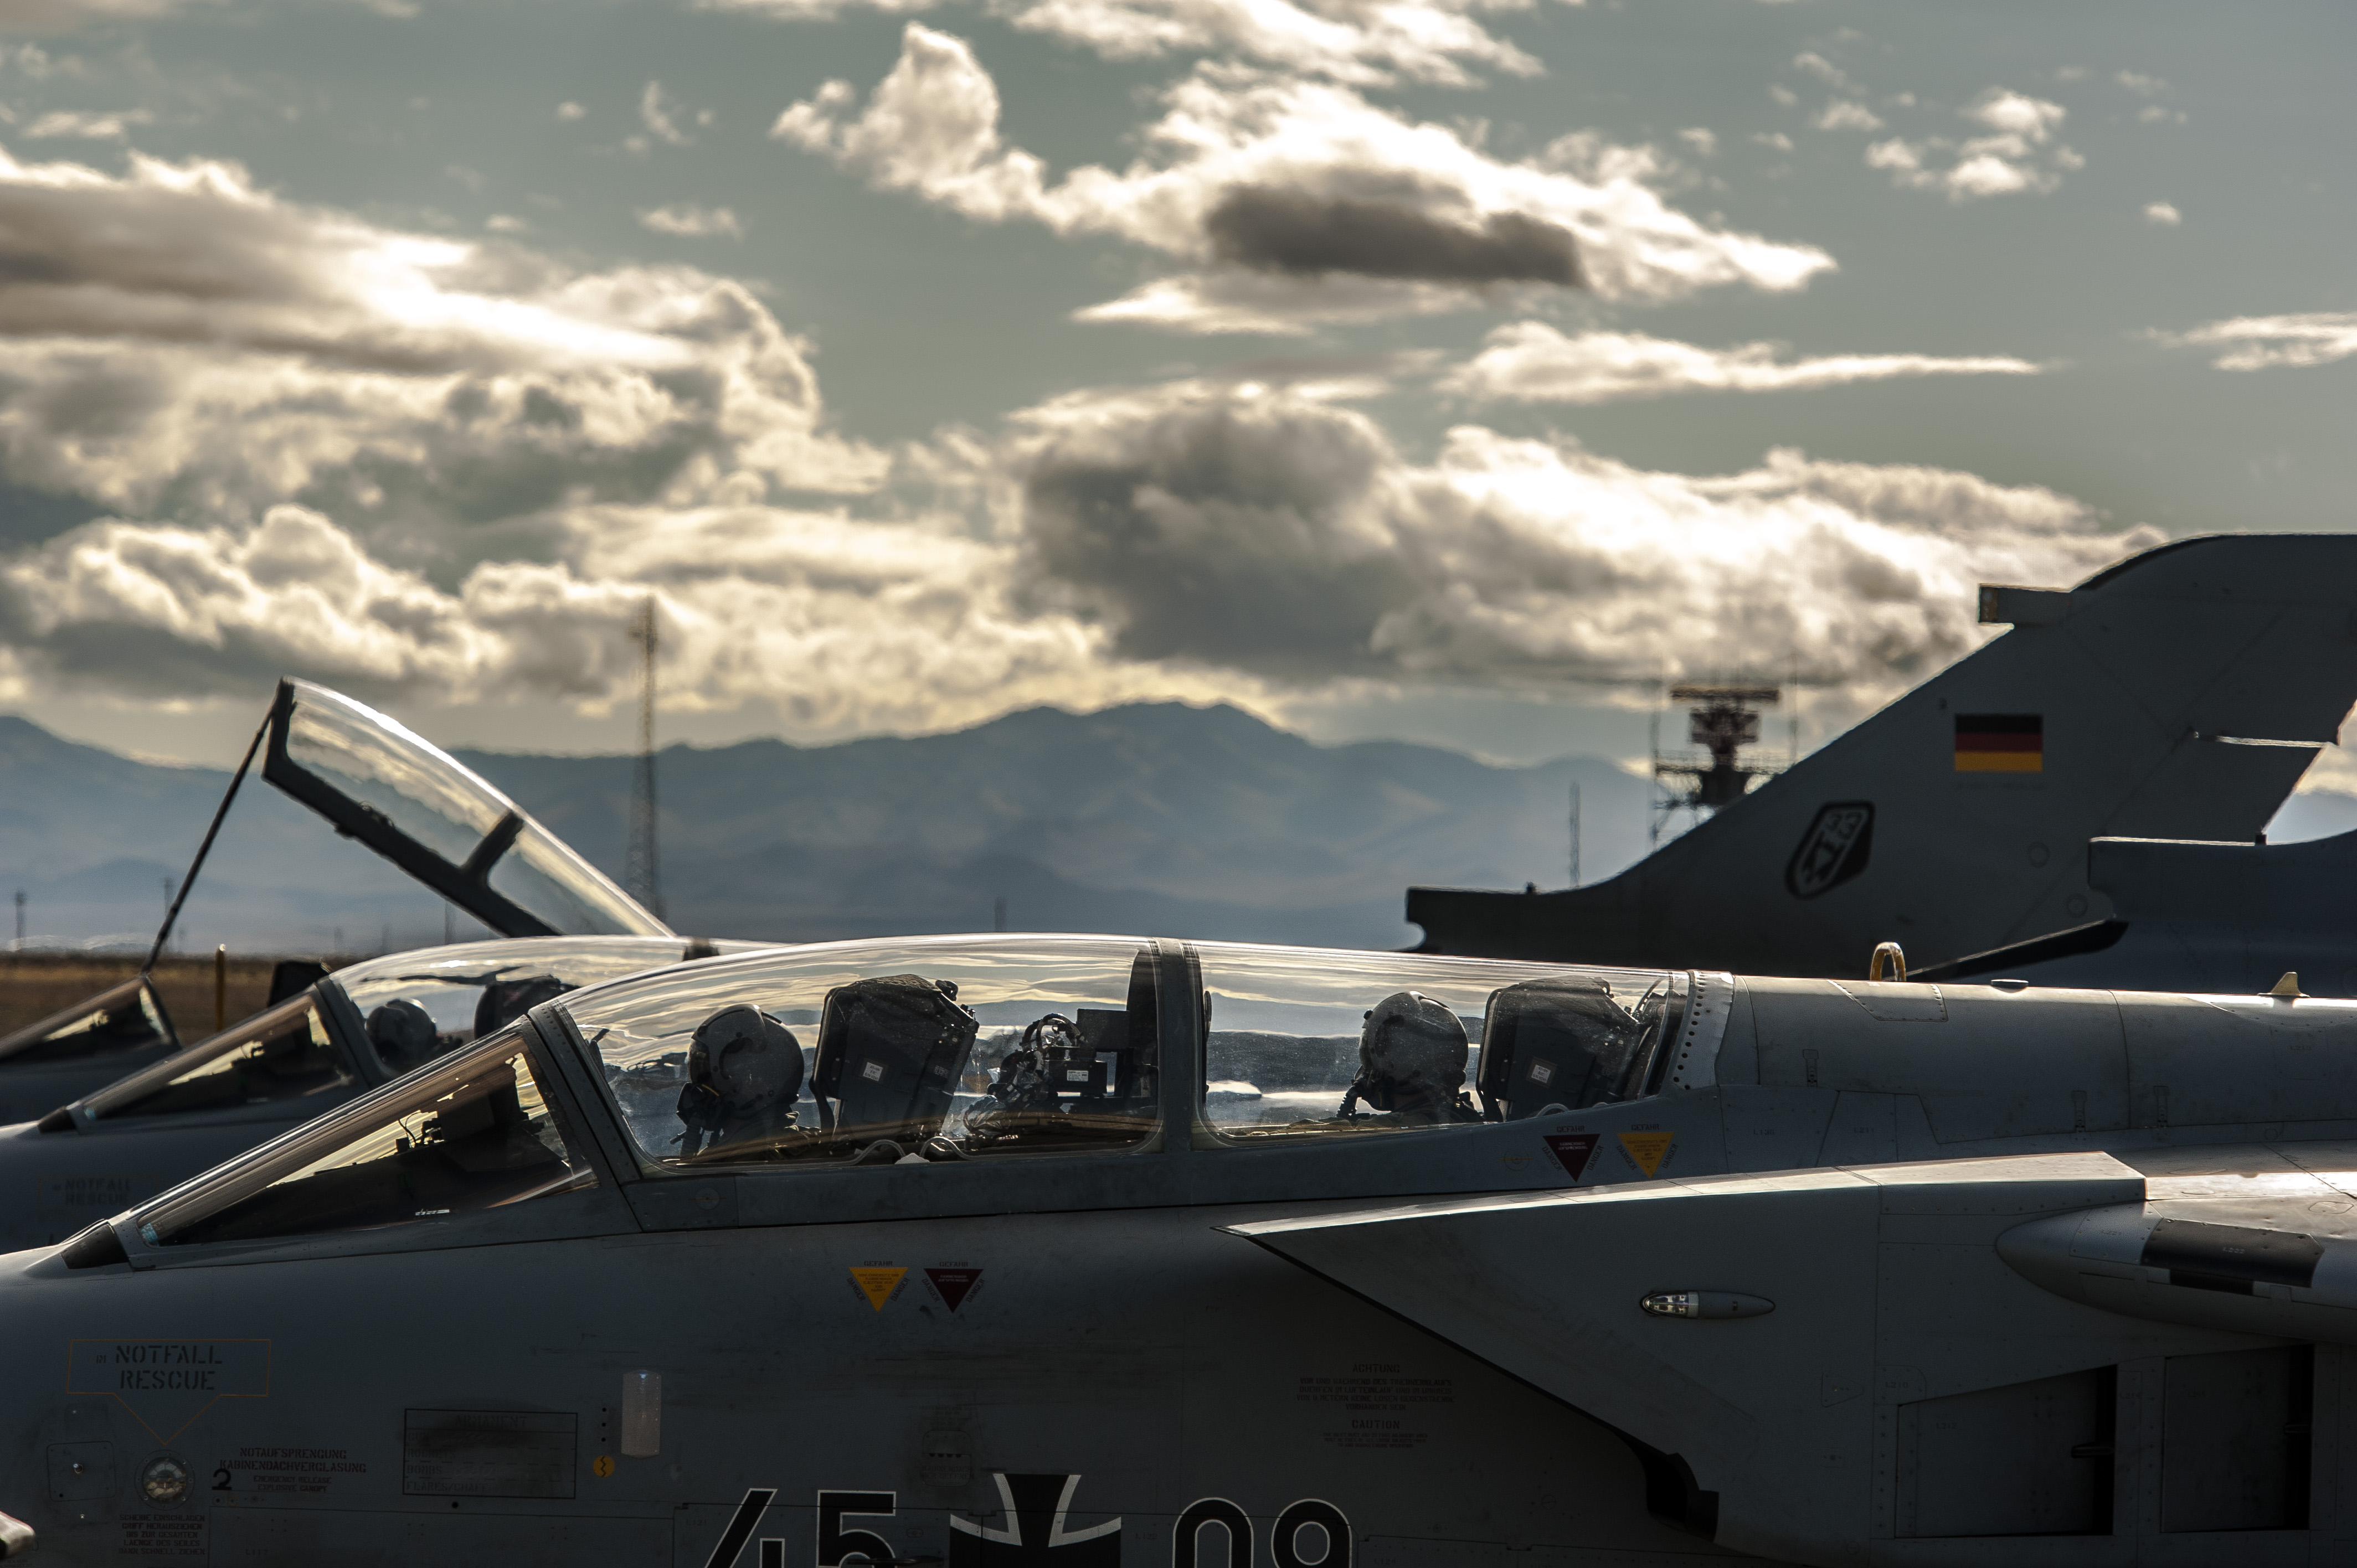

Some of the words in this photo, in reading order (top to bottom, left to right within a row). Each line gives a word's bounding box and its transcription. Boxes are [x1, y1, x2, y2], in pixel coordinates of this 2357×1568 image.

[1542, 1146, 1562, 1171] DANGER
[1587, 1146, 1604, 1170] DANGER
[1617, 1144, 1637, 1170] DANGER
[1661, 1143, 1679, 1168] DANGER
[847, 1277, 866, 1302] DANGER
[891, 1277, 910, 1301] DANGER
[922, 1278, 940, 1302] DANGER
[965, 1278, 985, 1303] DANGER
[116, 1345, 222, 1364] NOTFALL
[1352, 1363, 1400, 1373] ACHTUNG
[120, 1370, 215, 1390] RESCUE
[455, 1415, 528, 1427] ARMAMENT
[1351, 1420, 1401, 1429] CAUTION
[240, 1447, 347, 1459] NOTAUFSPRENGUNG
[220, 1459, 367, 1473] KABINENDACHVERGLASUNG
[407, 1464, 442, 1474] BOMBS
[212, 1468, 232, 1490] 2
[705, 1488, 897, 1568] 45
